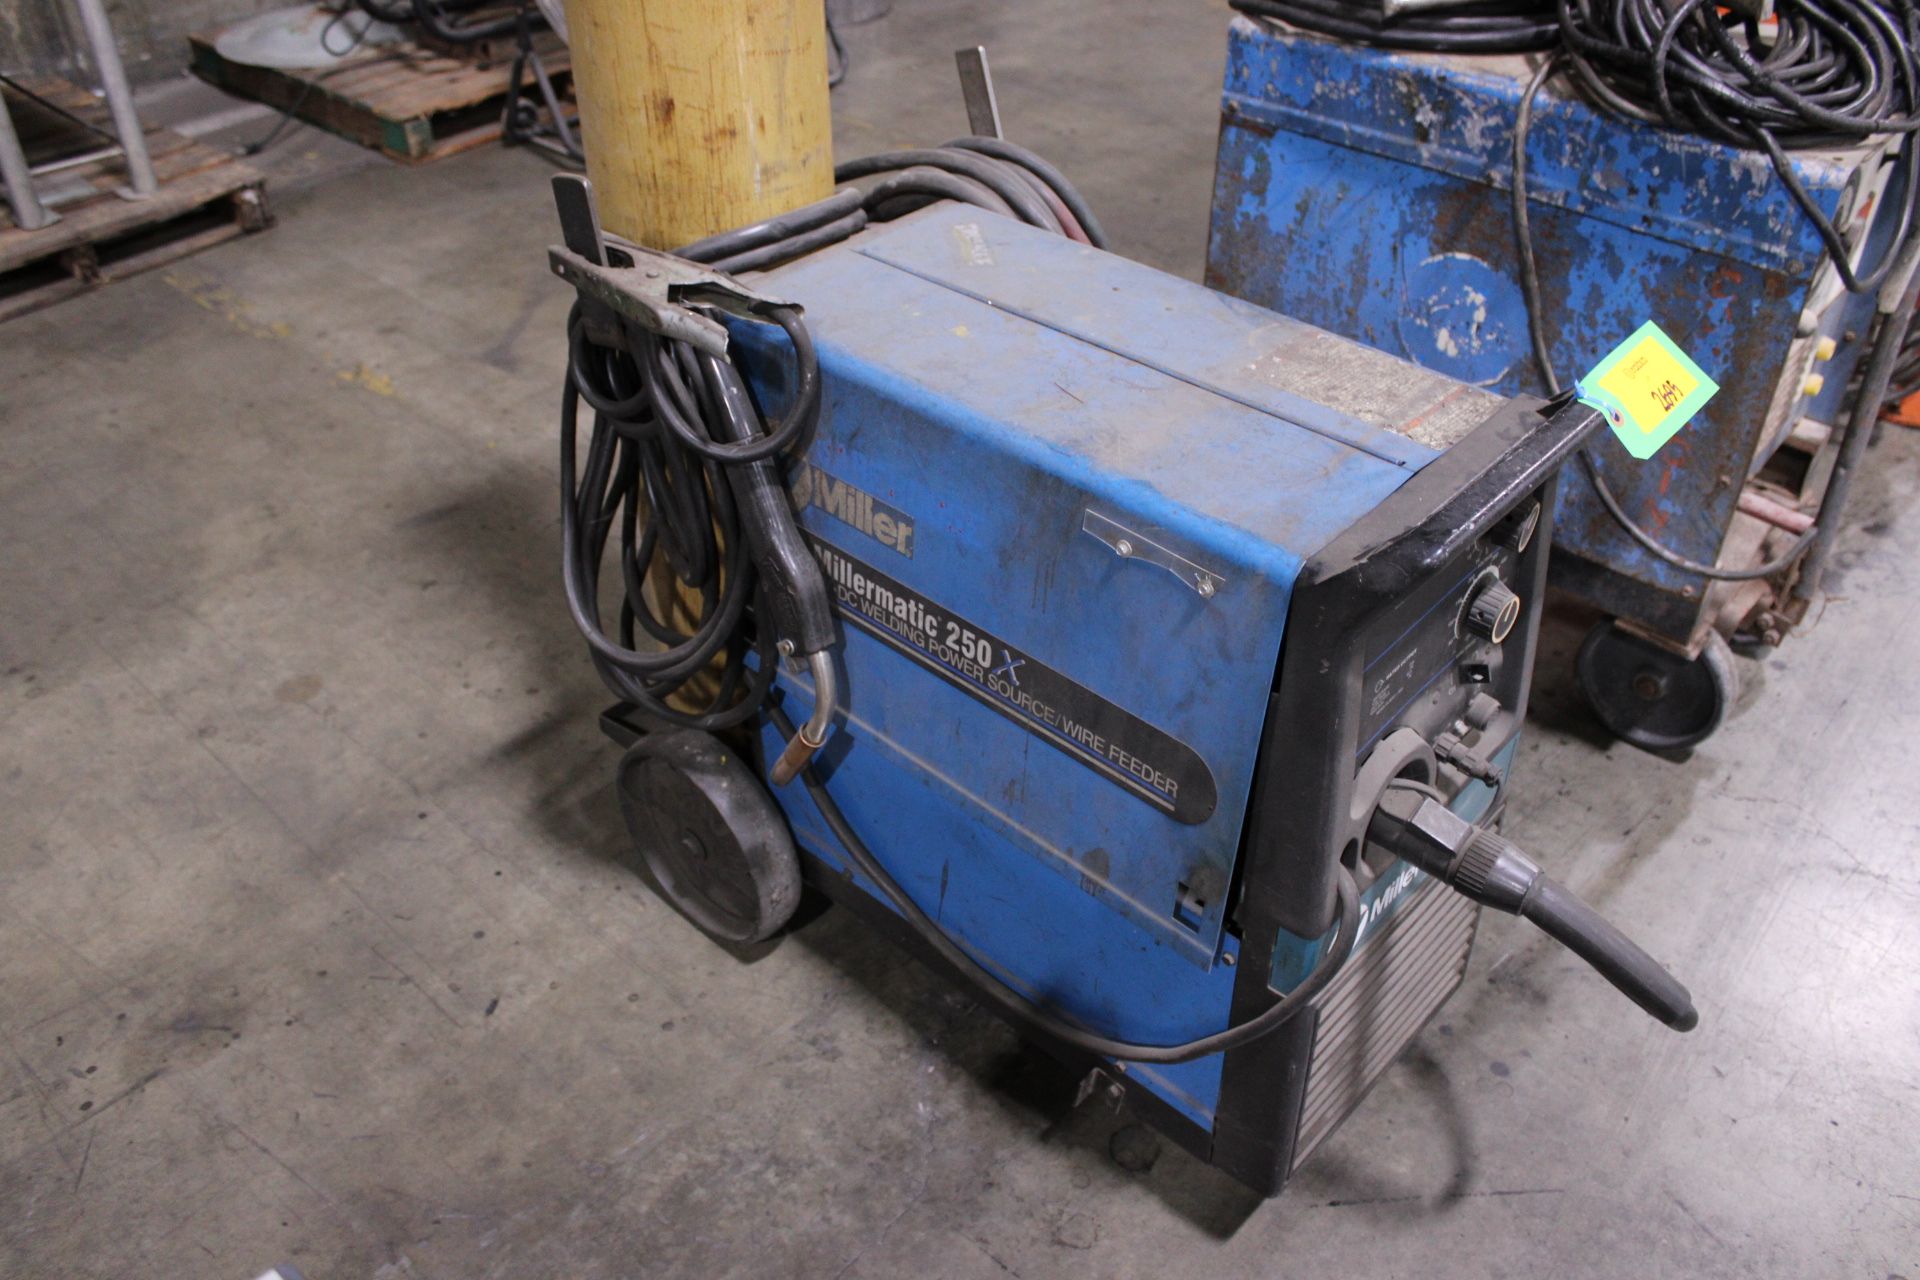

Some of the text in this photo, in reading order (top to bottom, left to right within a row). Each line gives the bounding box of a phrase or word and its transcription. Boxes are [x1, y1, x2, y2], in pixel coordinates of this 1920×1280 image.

[814, 468, 912, 554] Miller
[945, 621, 992, 669] 250
[861, 599, 925, 649] WELDING
[928, 637, 984, 684] POWER
[1109, 744, 1178, 798] FEEDER
